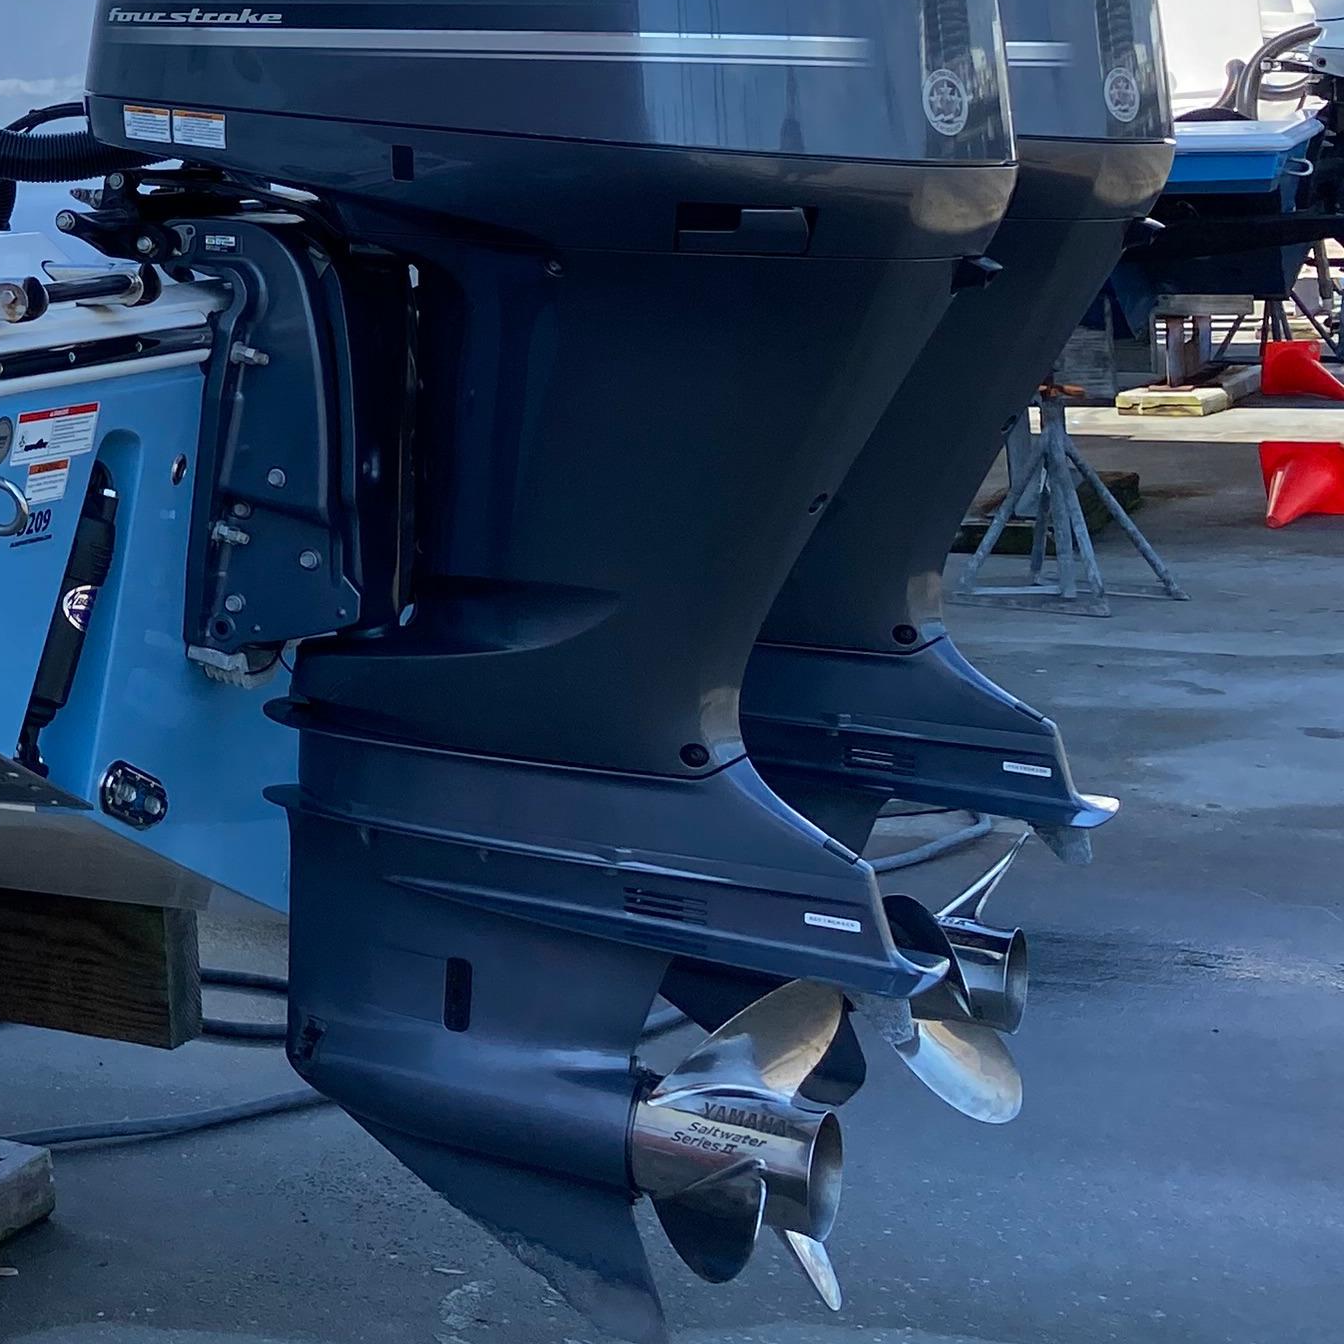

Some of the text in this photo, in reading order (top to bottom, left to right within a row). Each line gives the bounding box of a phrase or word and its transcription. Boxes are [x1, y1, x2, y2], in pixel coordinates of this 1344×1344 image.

[703, 1101, 787, 1137] YAMAHA
[670, 1130, 720, 1153] Series
[687, 1121, 768, 1148] Saltwater
